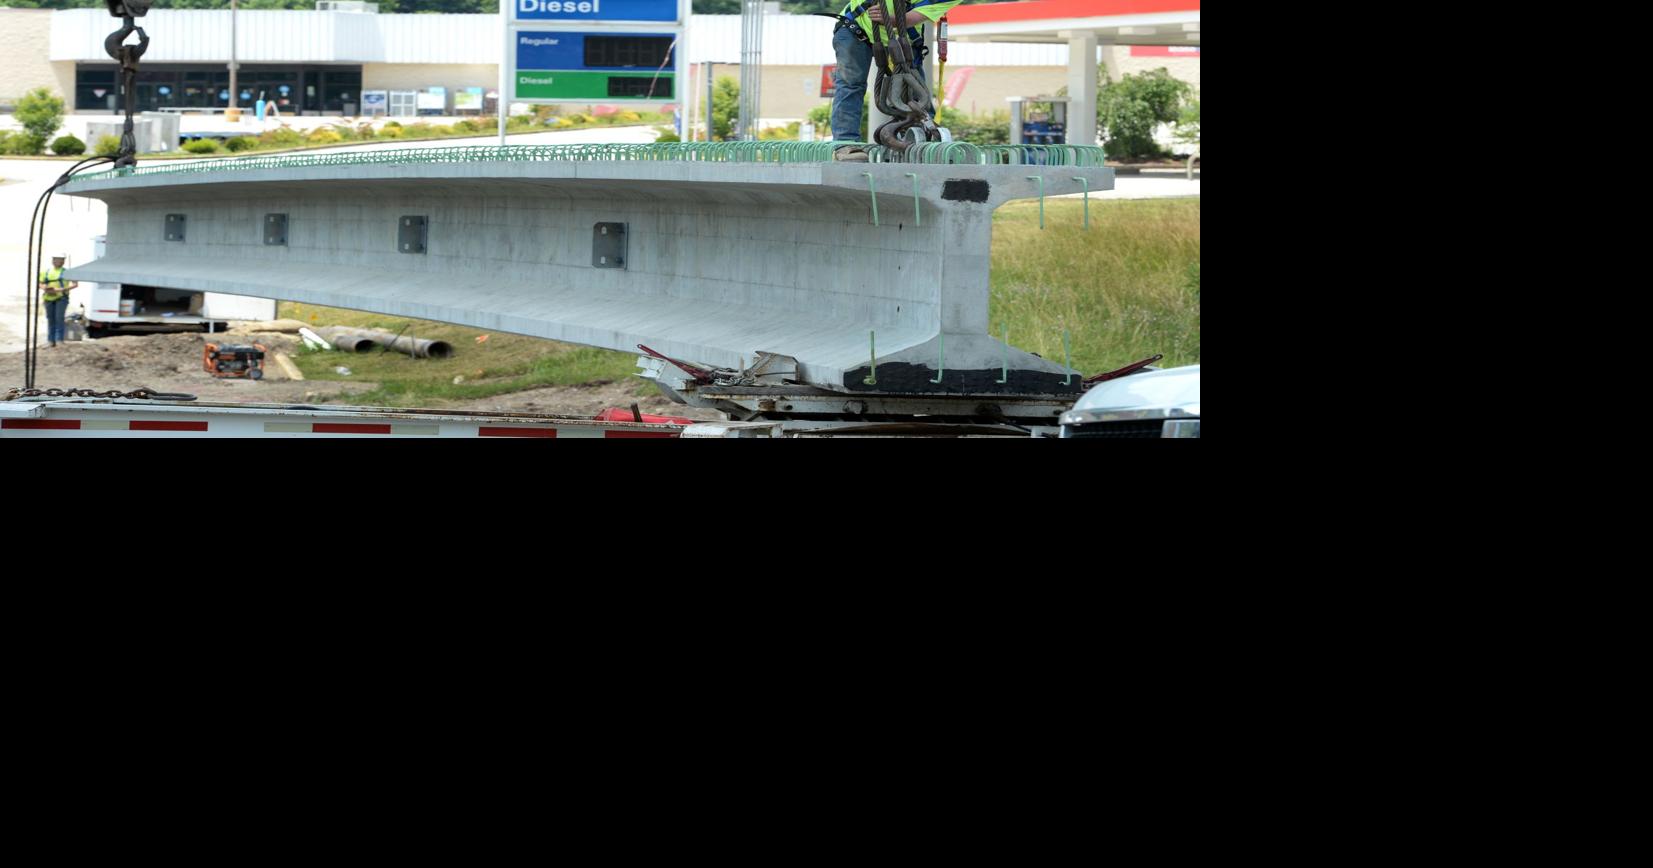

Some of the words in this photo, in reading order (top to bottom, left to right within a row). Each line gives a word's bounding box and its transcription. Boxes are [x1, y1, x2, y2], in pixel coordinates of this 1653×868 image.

[519, 0, 599, 13] Diesel
[520, 37, 559, 46] Regular
[520, 77, 553, 85] Diesel
